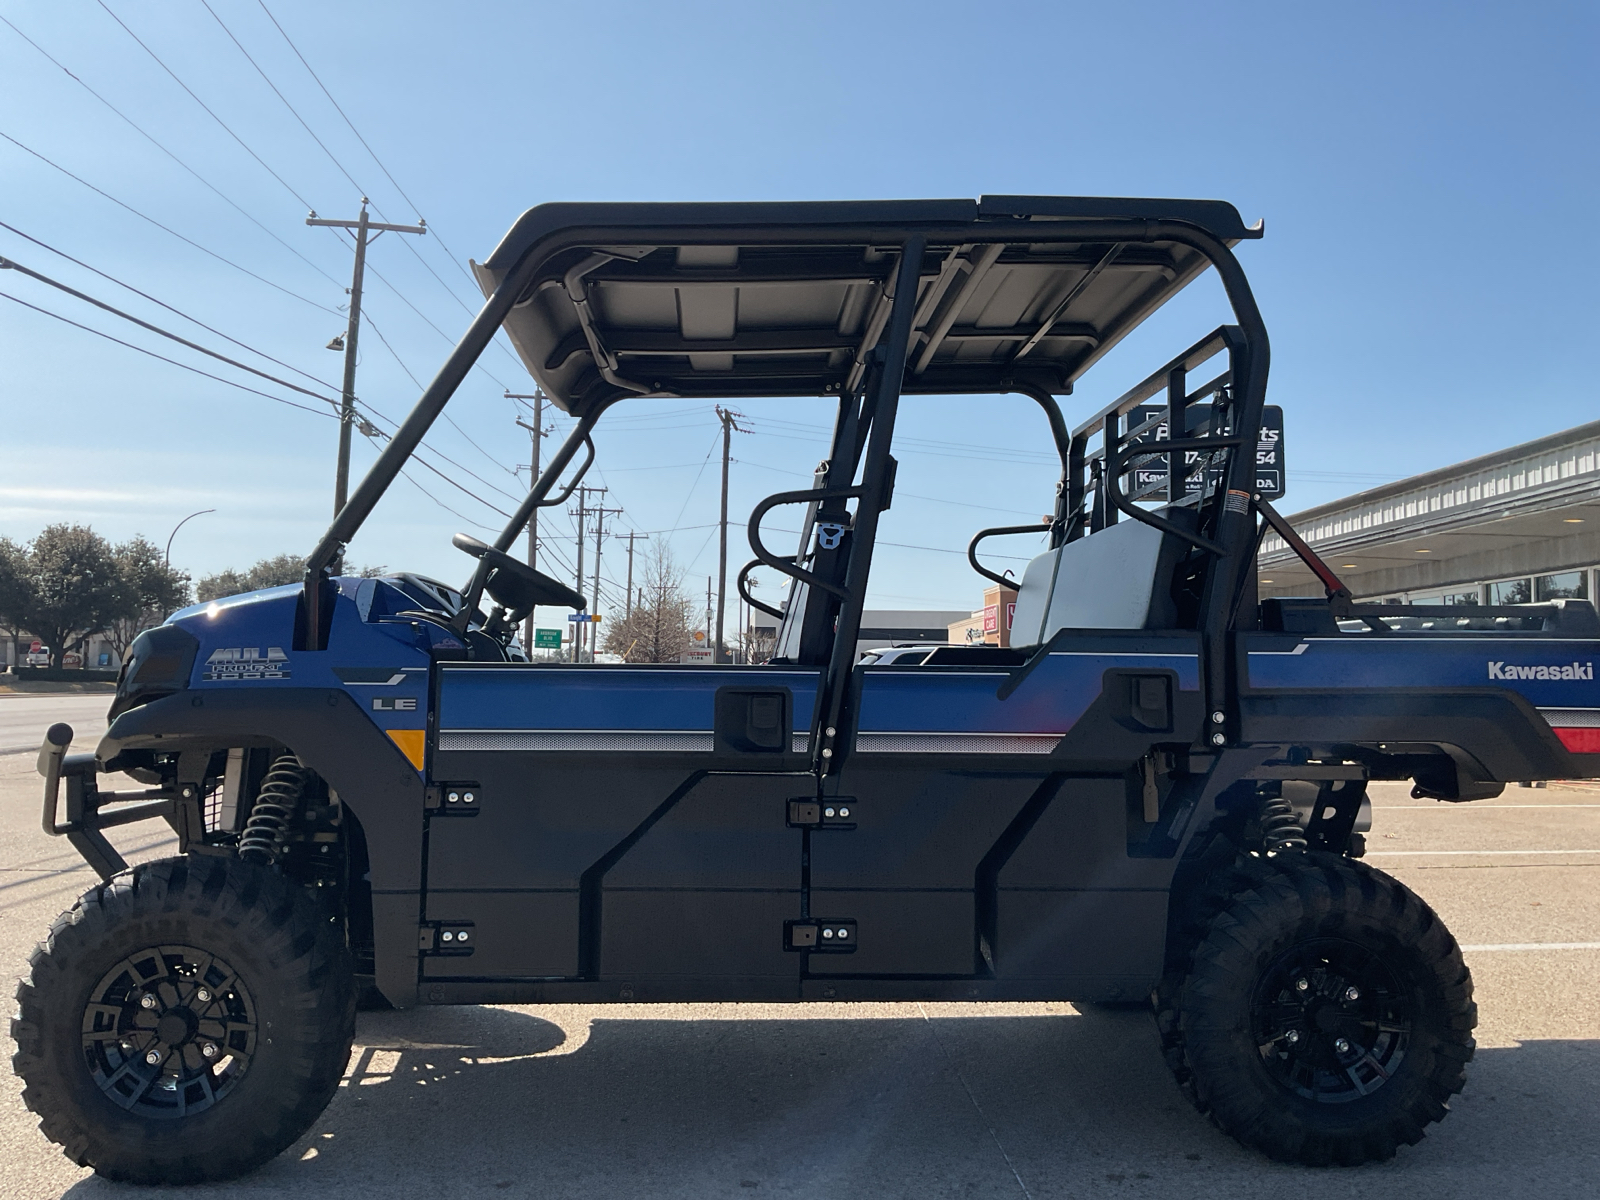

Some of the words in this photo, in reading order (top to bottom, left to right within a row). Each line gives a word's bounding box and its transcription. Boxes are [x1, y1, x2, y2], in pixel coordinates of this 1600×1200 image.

[986, 619, 995, 629] CARE
[205, 647, 291, 666] MULE
[206, 672, 283, 680] 1000
[1488, 661, 1594, 680] Kawasaki
[373, 699, 417, 710] LE
